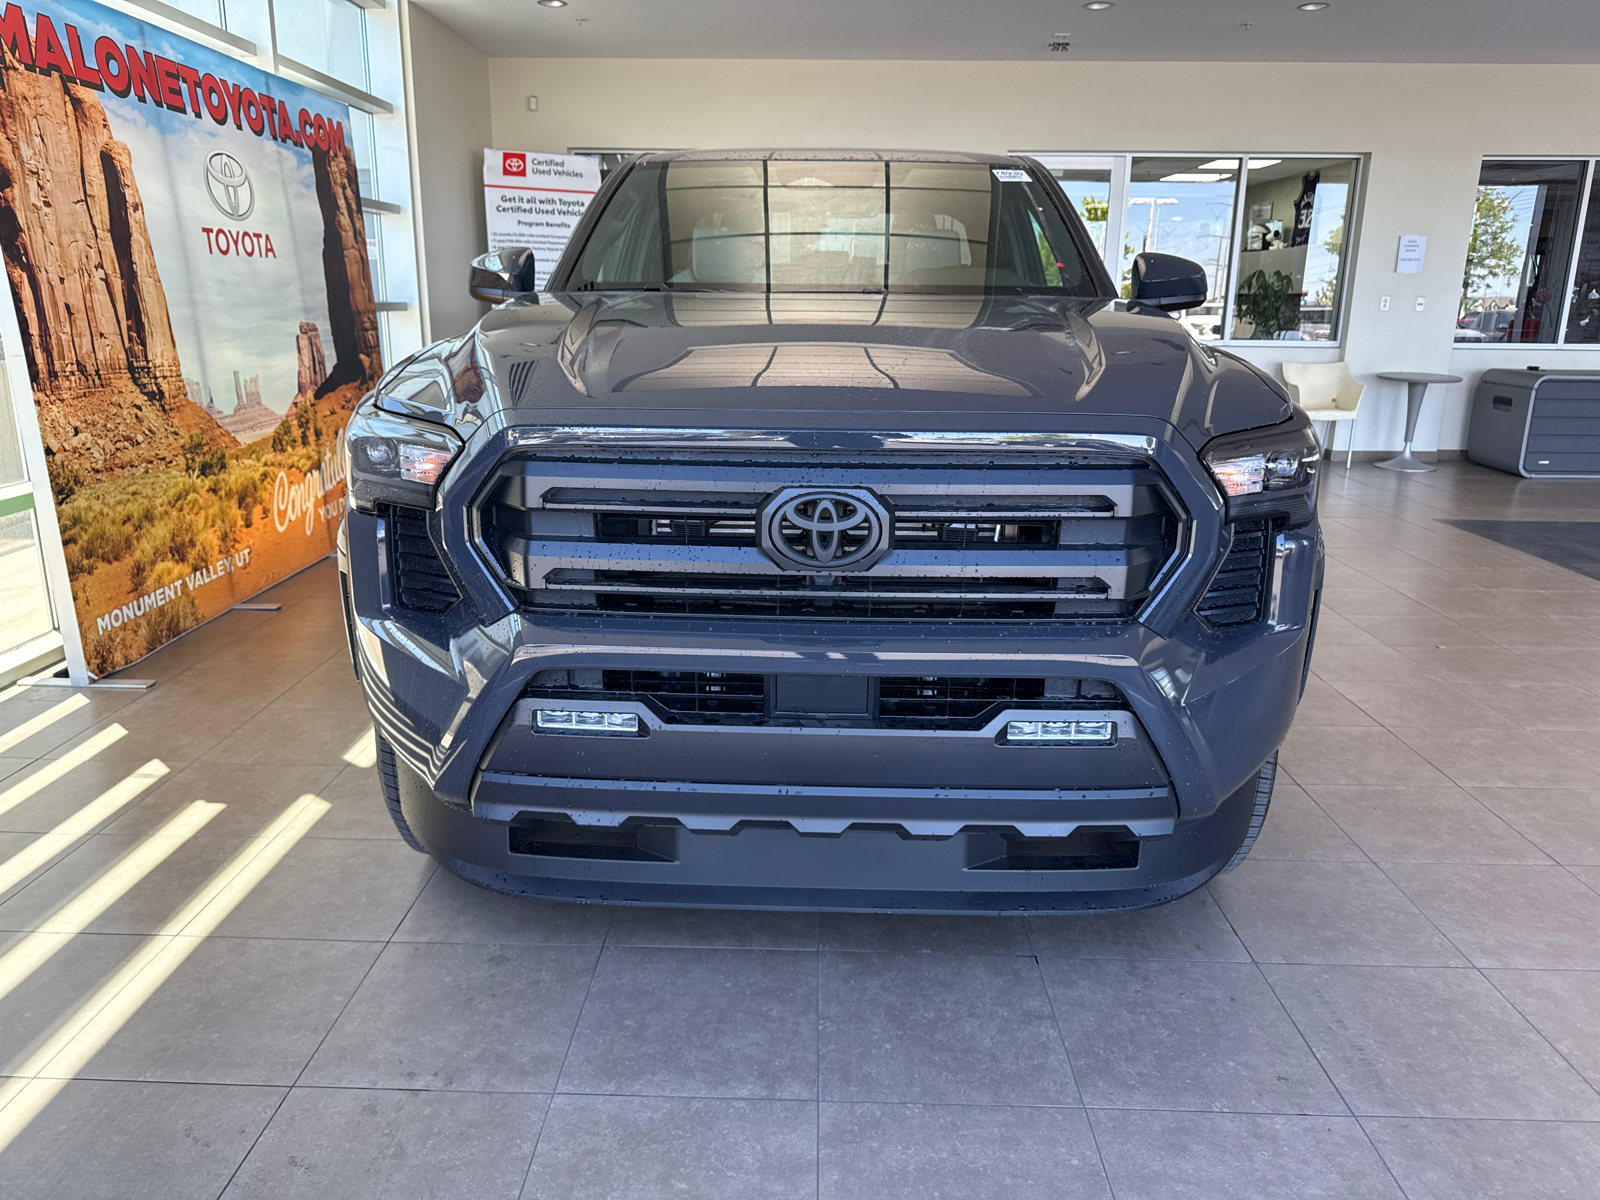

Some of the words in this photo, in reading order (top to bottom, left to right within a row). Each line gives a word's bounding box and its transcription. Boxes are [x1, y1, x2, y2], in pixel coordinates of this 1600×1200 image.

[0, 2, 347, 155] MALONETOYOTA.COM
[531, 158, 565, 167] Certified
[532, 167, 552, 176] Used
[553, 169, 584, 178] Vehicles
[500, 195, 516, 204] Get
[518, 196, 525, 204] it
[526, 196, 537, 205] all
[538, 197, 557, 206] with
[558, 199, 585, 208] Toyota
[496, 205, 533, 214] Certified
[534, 207, 556, 216] Used
[517, 220, 545, 229] Program
[546, 221, 571, 229] Benefits
[201, 227, 277, 259] TOYOTA
[96, 580, 183, 636] MONUMENT
[185, 556, 235, 592] VALLEY,
[235, 548, 251, 568] UT
